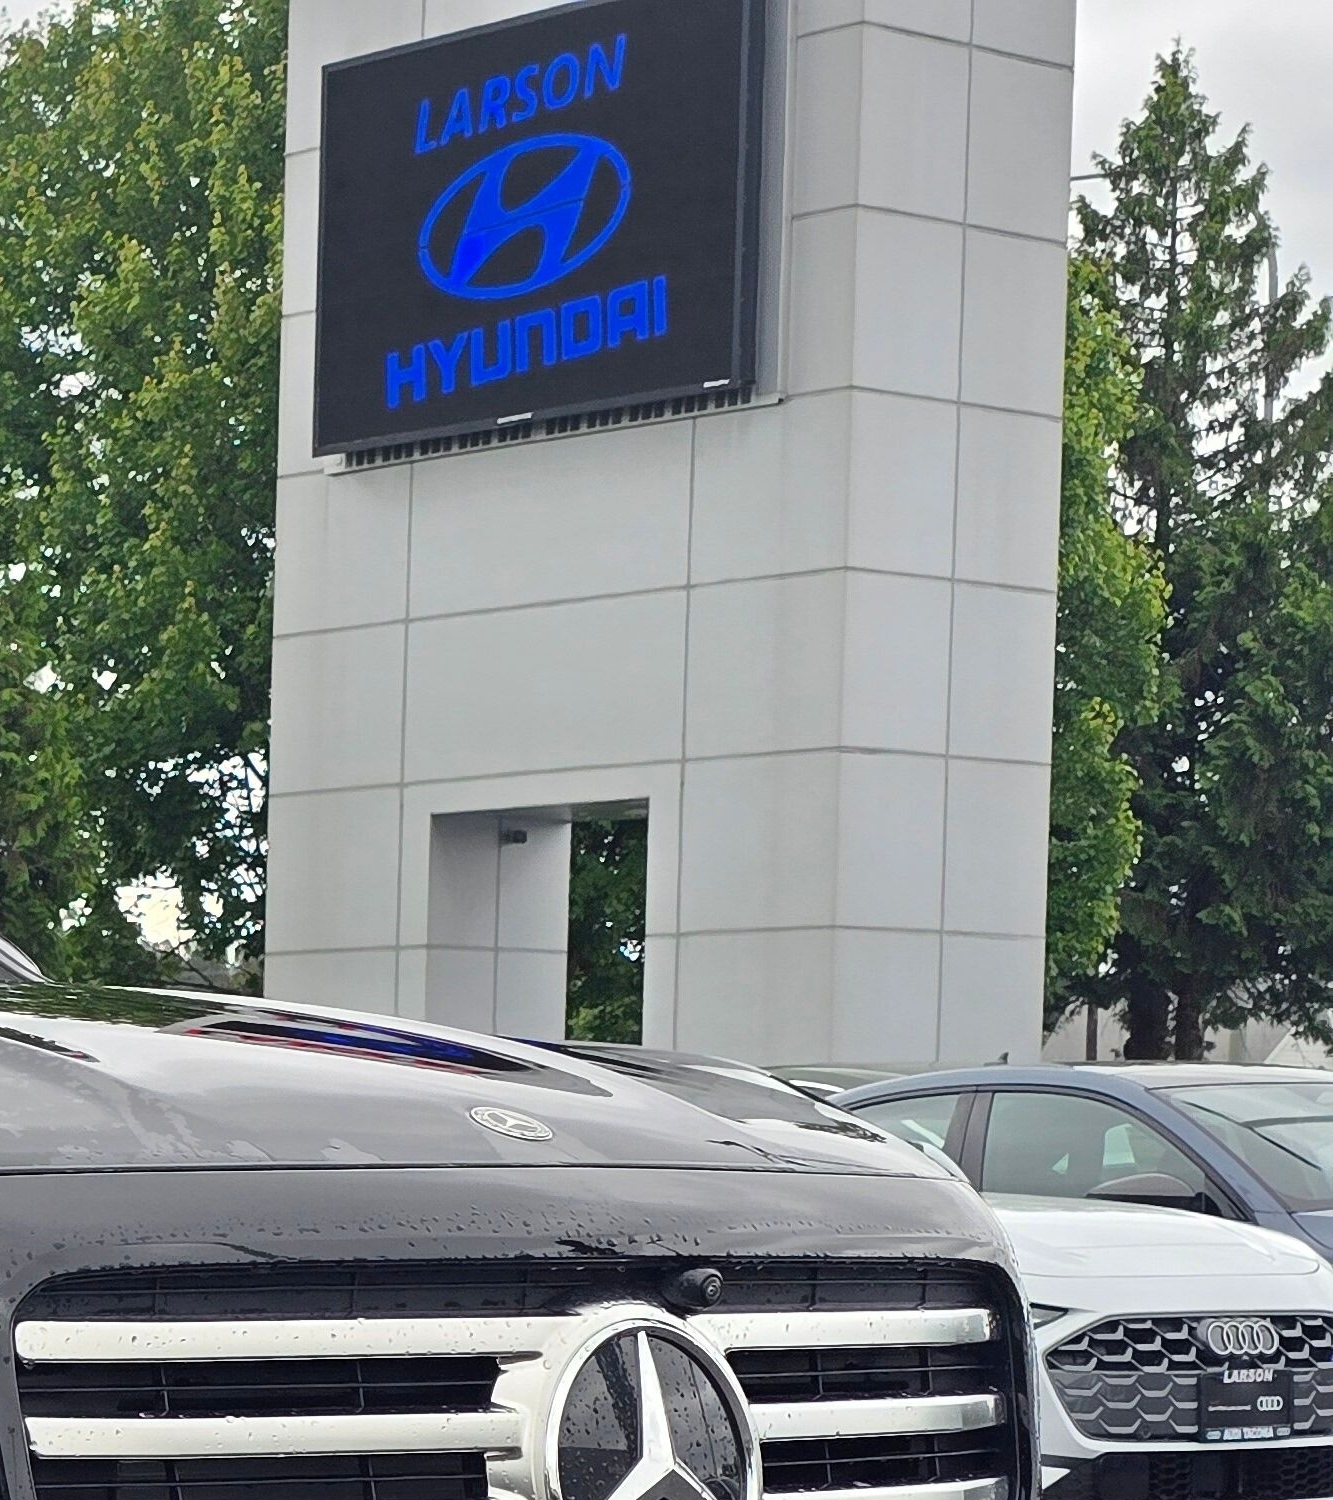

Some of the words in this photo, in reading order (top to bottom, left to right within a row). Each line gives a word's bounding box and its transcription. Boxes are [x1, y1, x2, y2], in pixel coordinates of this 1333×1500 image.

[413, 33, 629, 156] LARSON
[384, 274, 670, 410] HYUNDAI
[1222, 1368, 1274, 1384] LARSON
